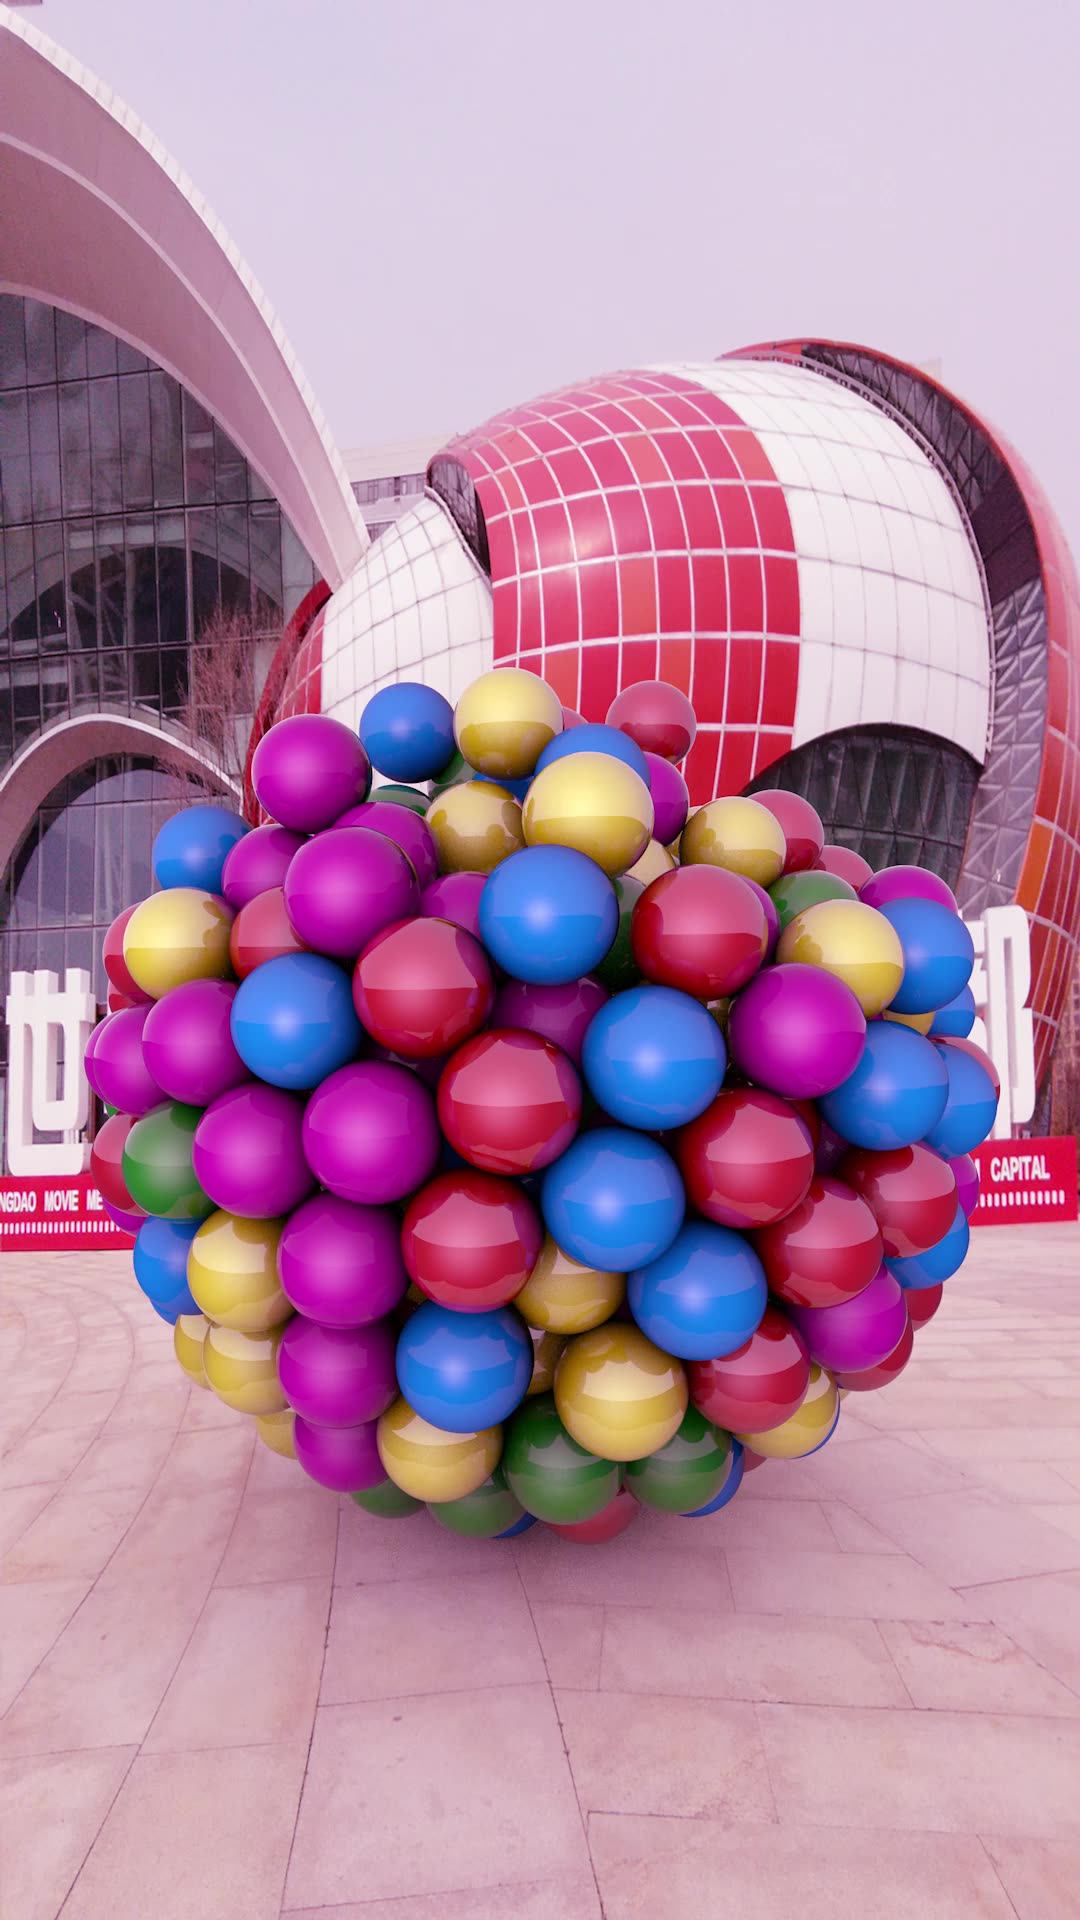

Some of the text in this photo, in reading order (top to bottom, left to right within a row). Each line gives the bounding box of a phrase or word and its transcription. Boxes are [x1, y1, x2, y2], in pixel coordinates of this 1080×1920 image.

[6, 968, 95, 1176] 世
[44, 1190, 79, 1211] MOVIE
[990, 1155, 1051, 1182] CAPITAL
